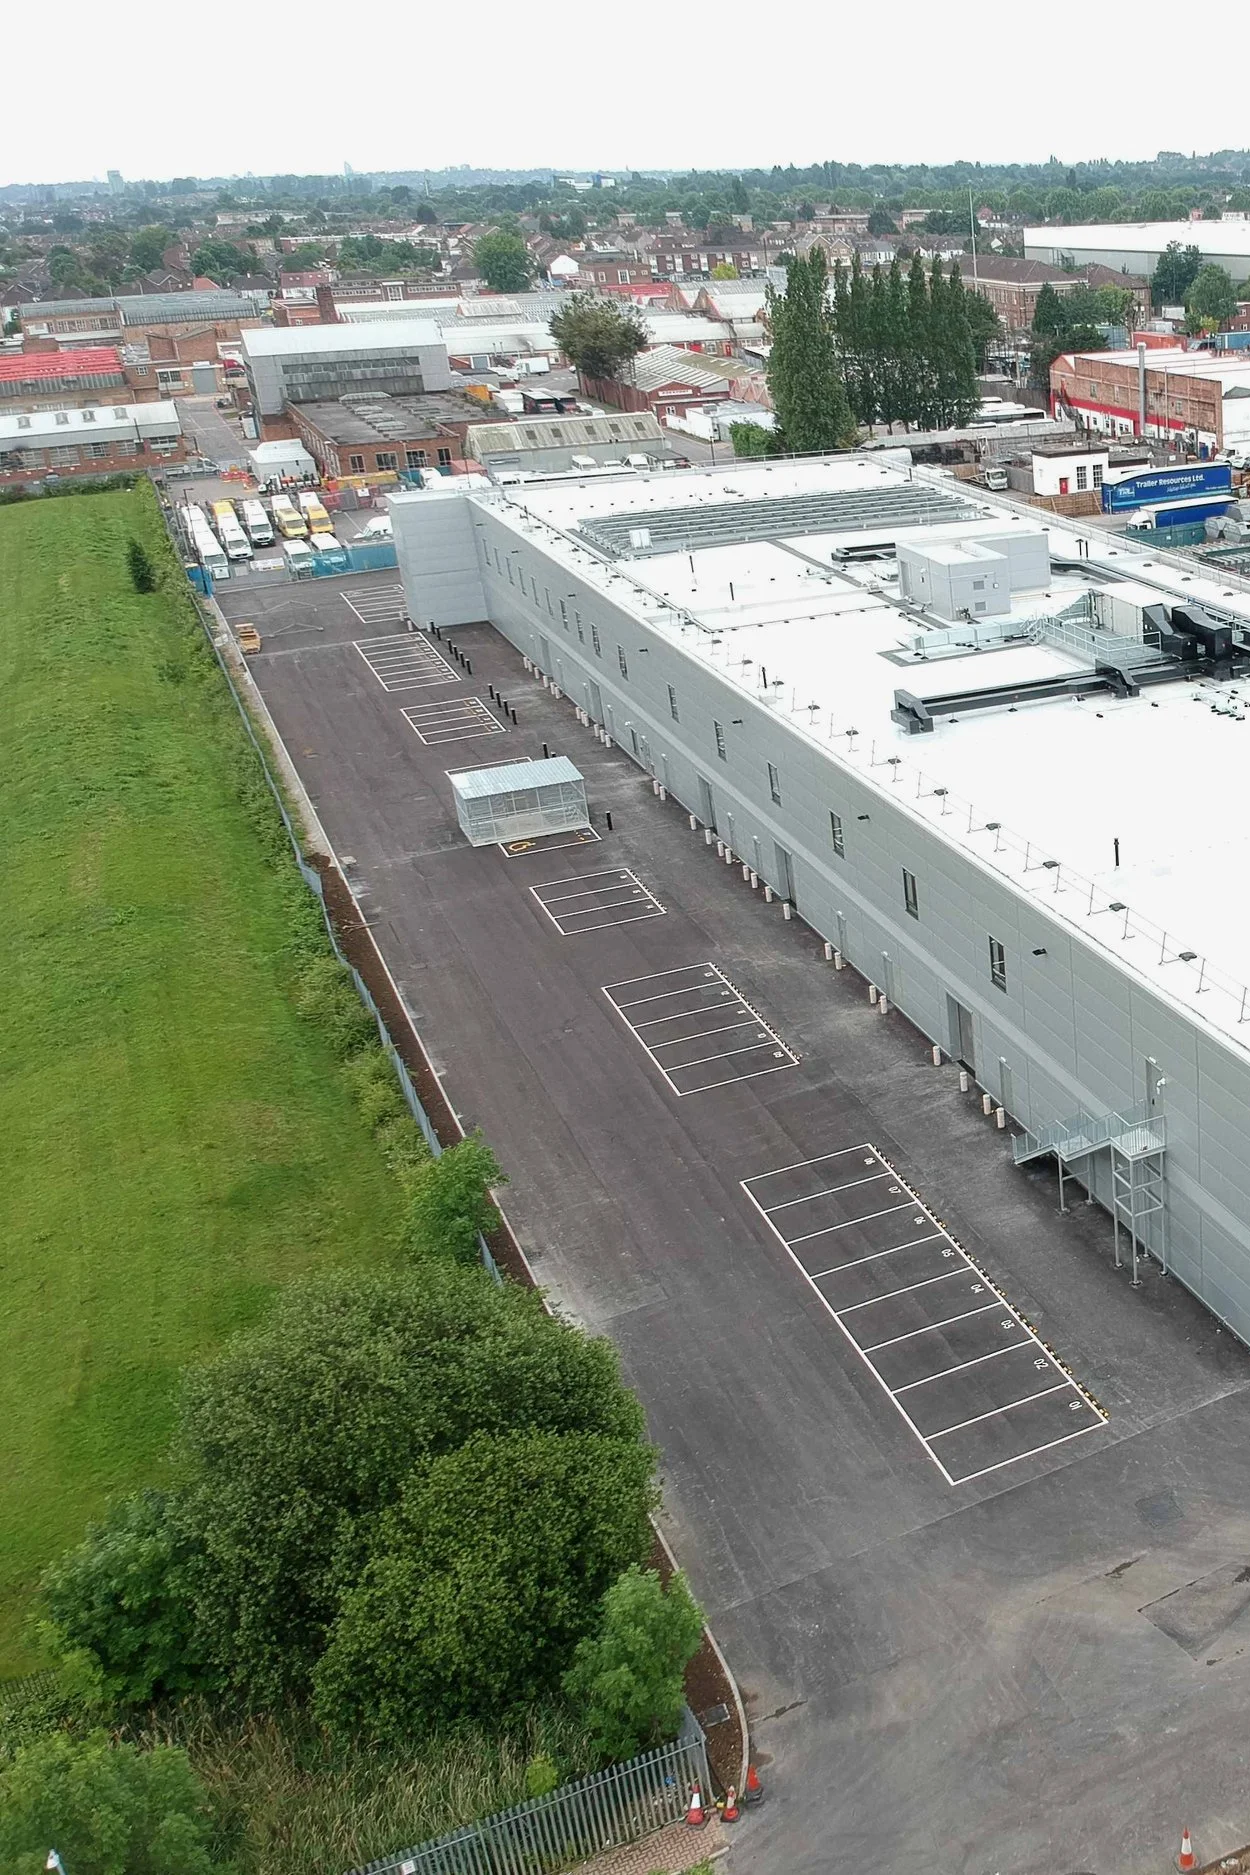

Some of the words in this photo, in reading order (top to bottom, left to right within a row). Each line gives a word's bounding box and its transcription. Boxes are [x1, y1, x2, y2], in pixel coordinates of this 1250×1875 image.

[1136, 478, 1159, 489] Trailer
[1158, 476, 1192, 486] Resources
[970, 1283, 985, 1294] 04
[1000, 1319, 1016, 1330] 03
[1033, 1358, 1049, 1370] 02
[1068, 1400, 1083, 1411] 01
